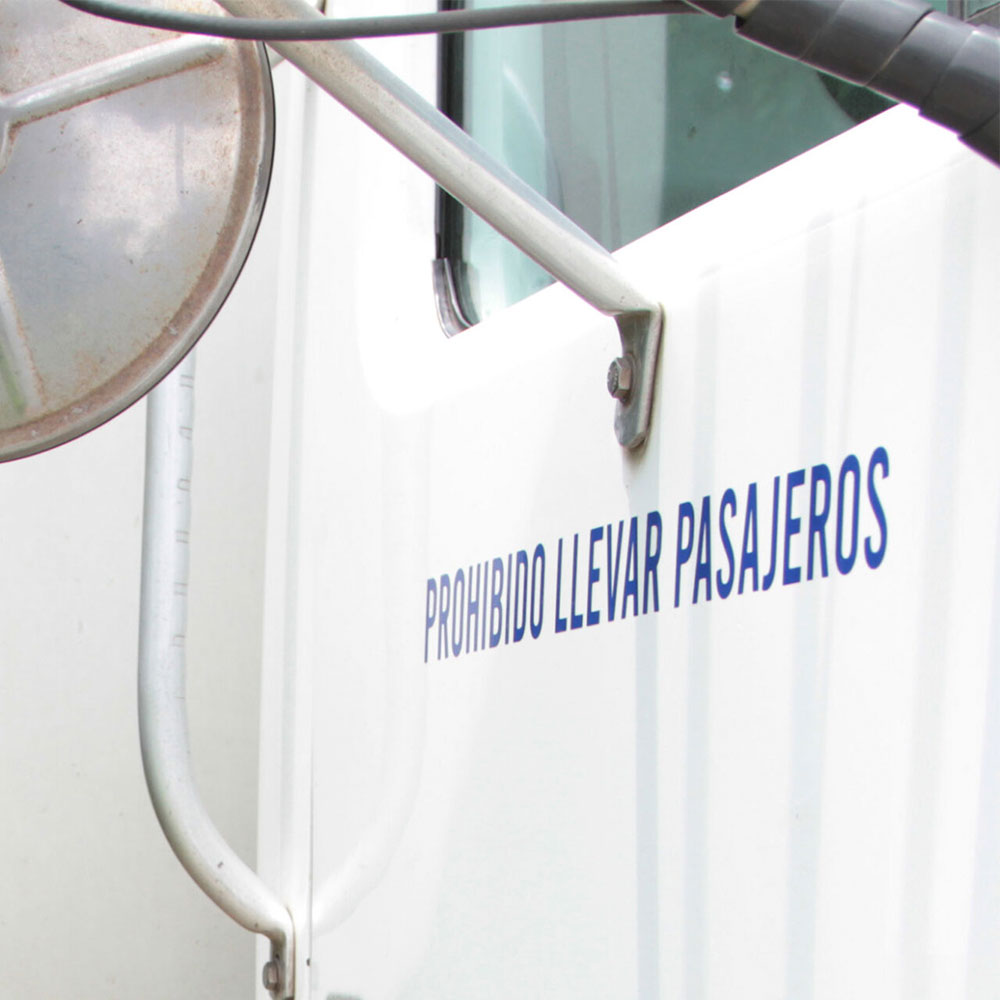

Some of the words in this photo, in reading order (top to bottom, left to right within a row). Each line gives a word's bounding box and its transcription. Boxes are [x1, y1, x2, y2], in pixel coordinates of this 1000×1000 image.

[424, 543, 546, 663] PROHIBIDO
[554, 510, 663, 634] LLEVAR
[673, 446, 890, 609] PASAJEROS
